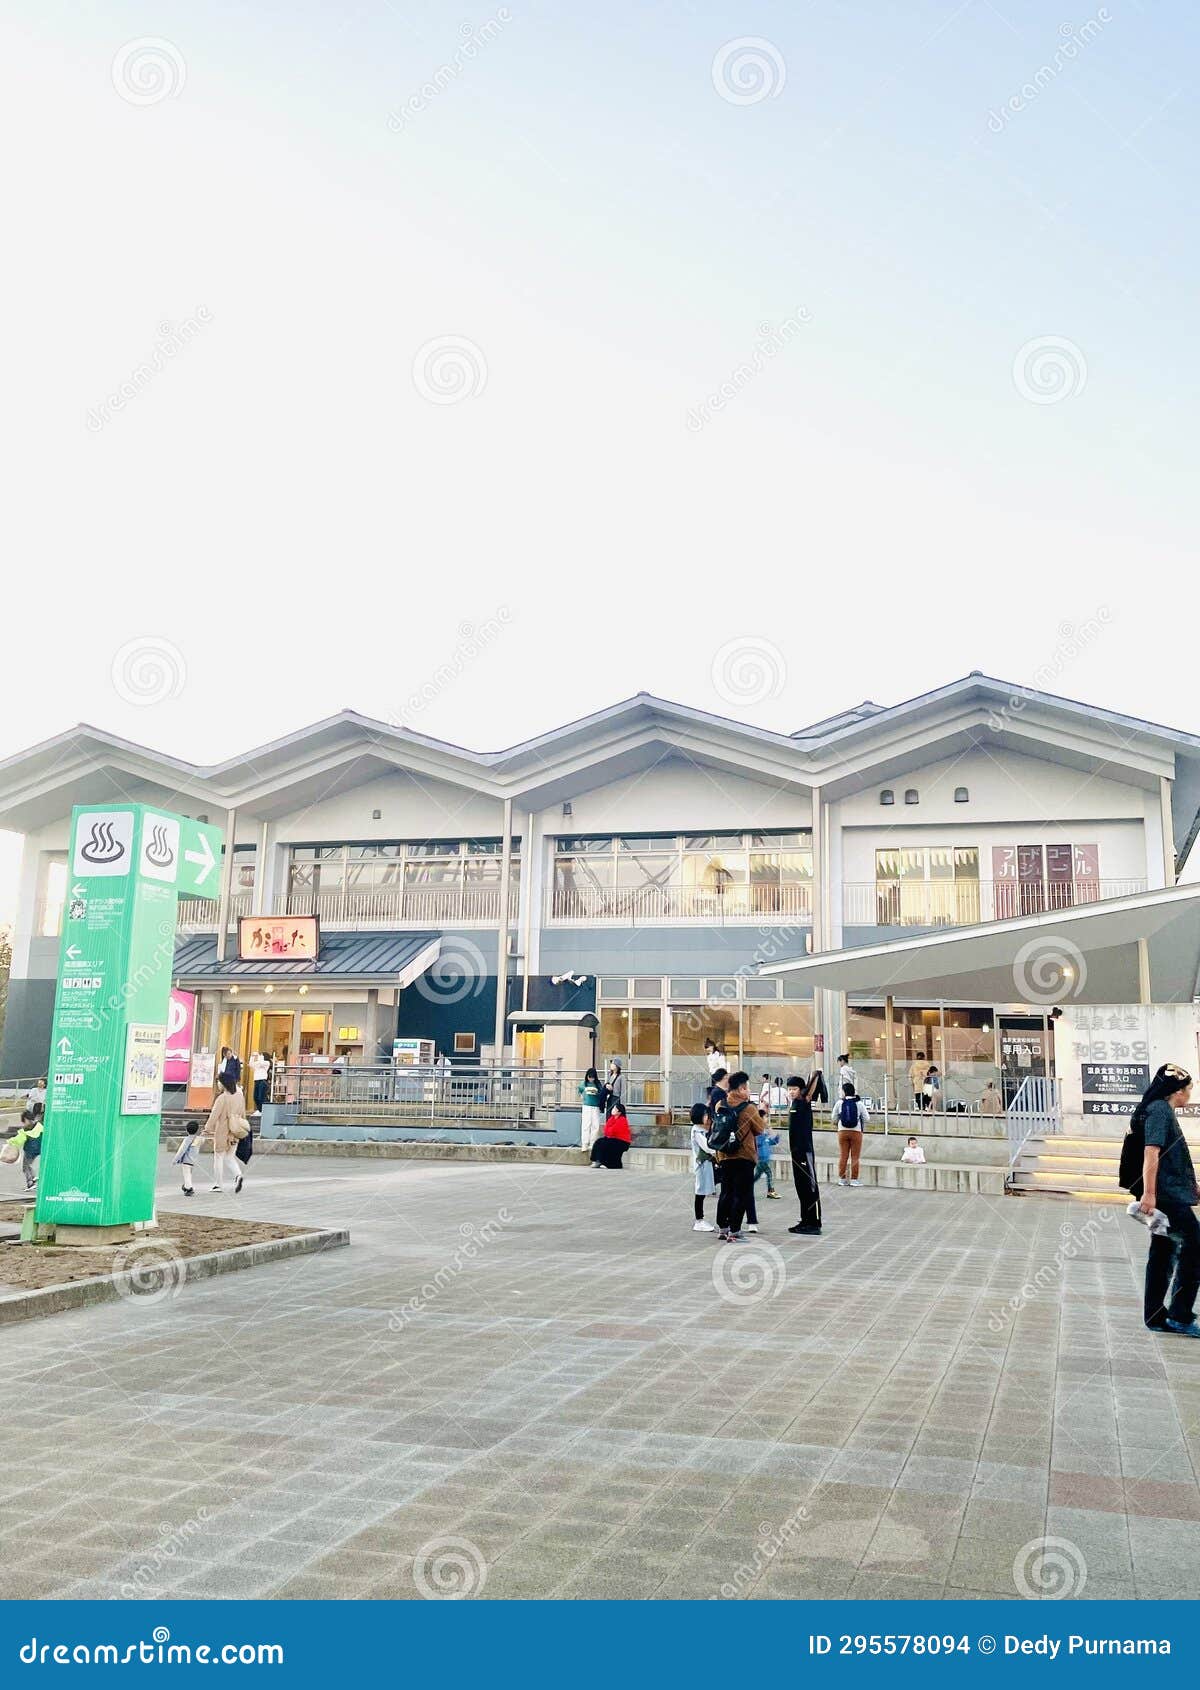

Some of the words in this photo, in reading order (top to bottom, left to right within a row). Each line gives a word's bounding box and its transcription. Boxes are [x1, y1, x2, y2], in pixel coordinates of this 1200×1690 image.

[1003, 848, 1085, 860] フードコート
